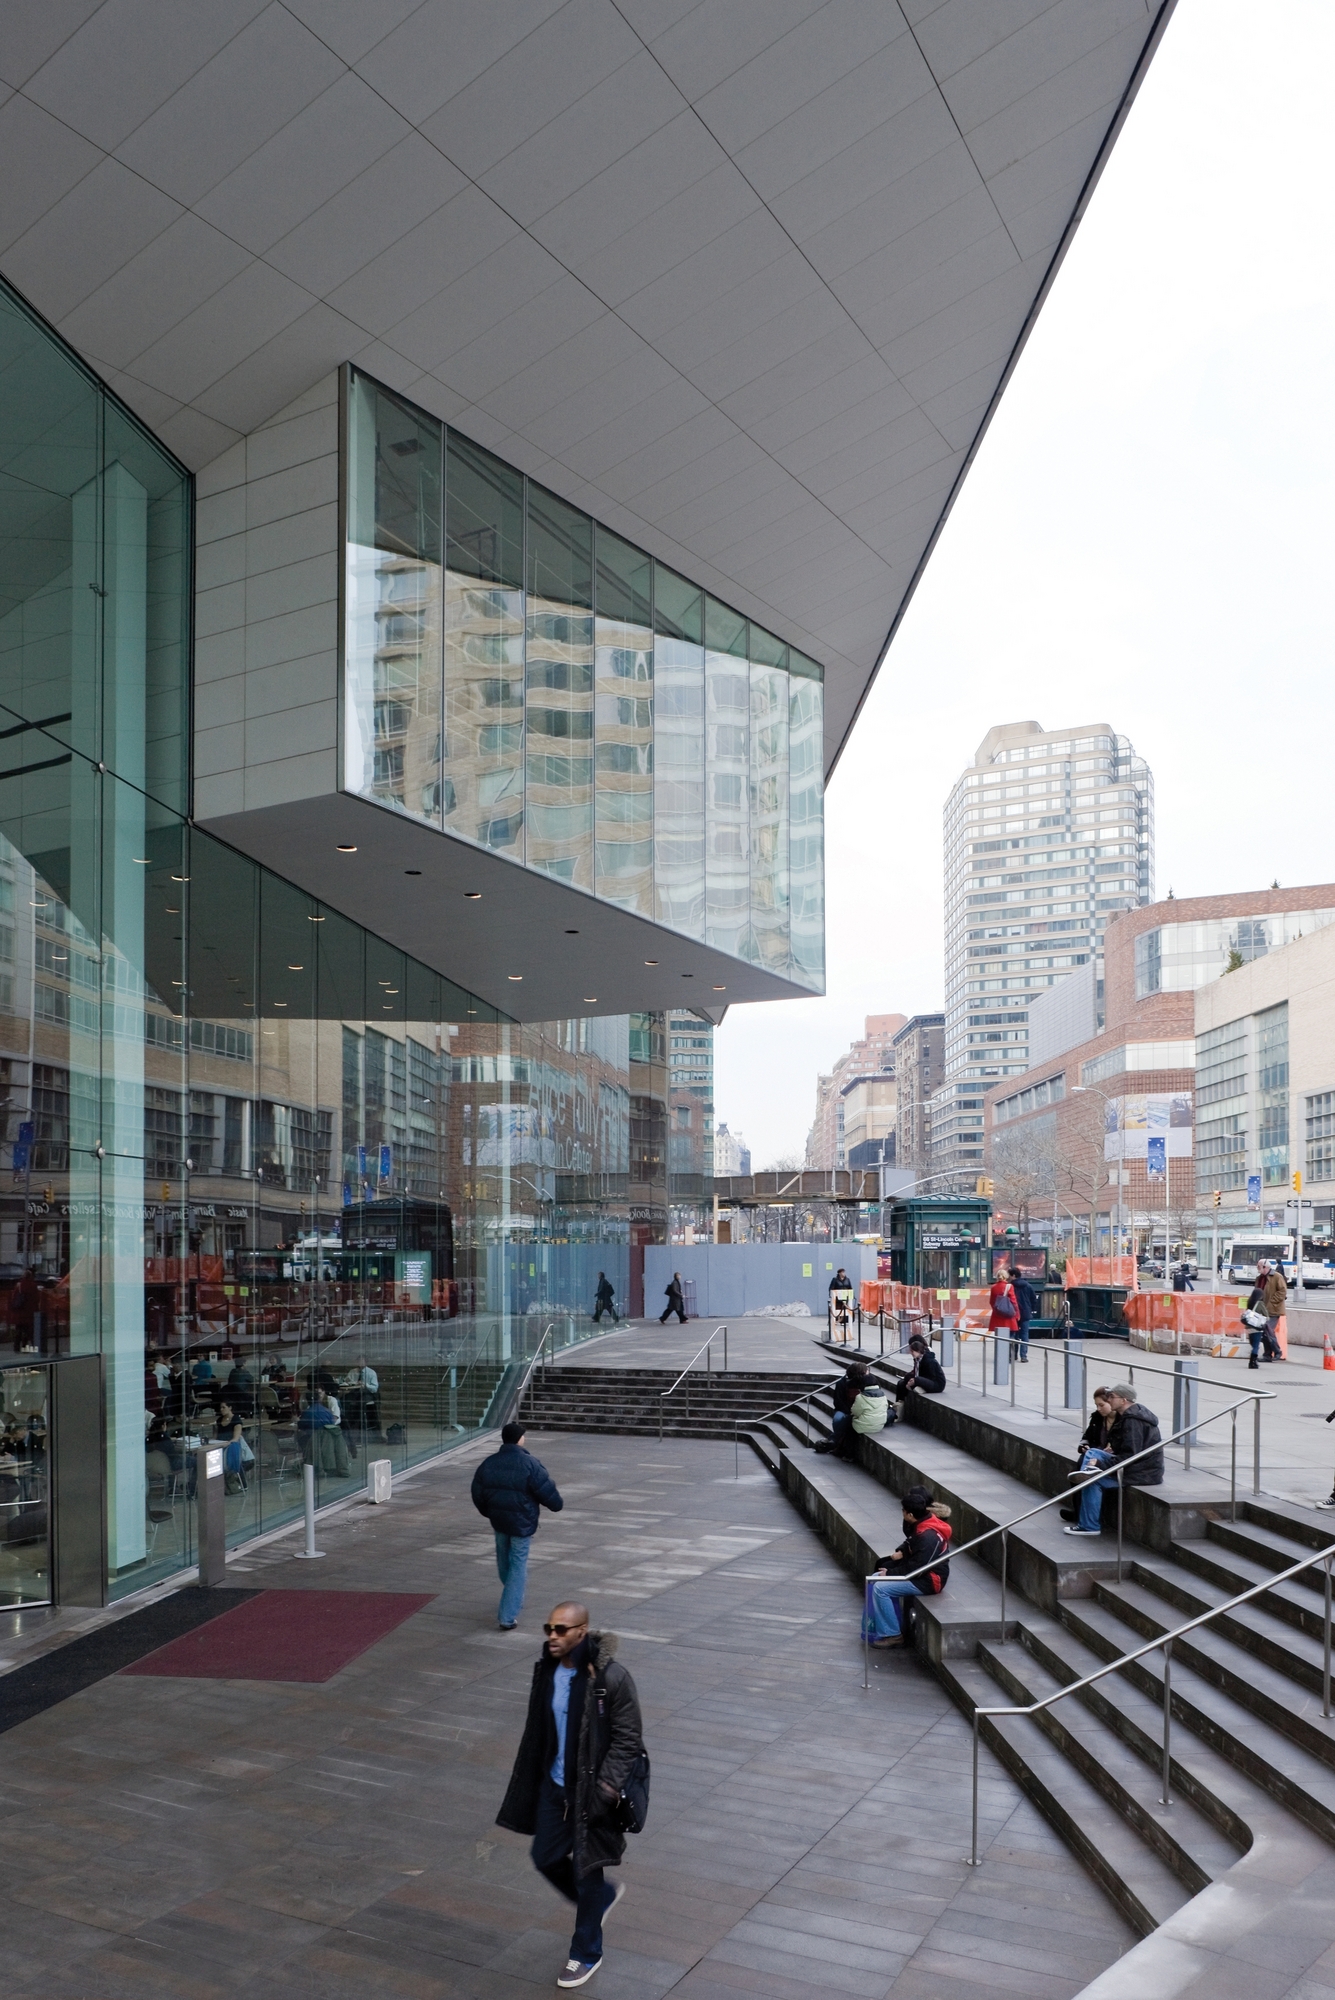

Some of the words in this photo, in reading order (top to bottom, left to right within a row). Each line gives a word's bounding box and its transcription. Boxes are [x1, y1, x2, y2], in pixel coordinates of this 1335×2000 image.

[528, 1056, 566, 1126] Alice
[570, 1076, 600, 1149] Tully
[602, 1094, 623, 1147] Hall
[565, 1135, 593, 1174] Center
